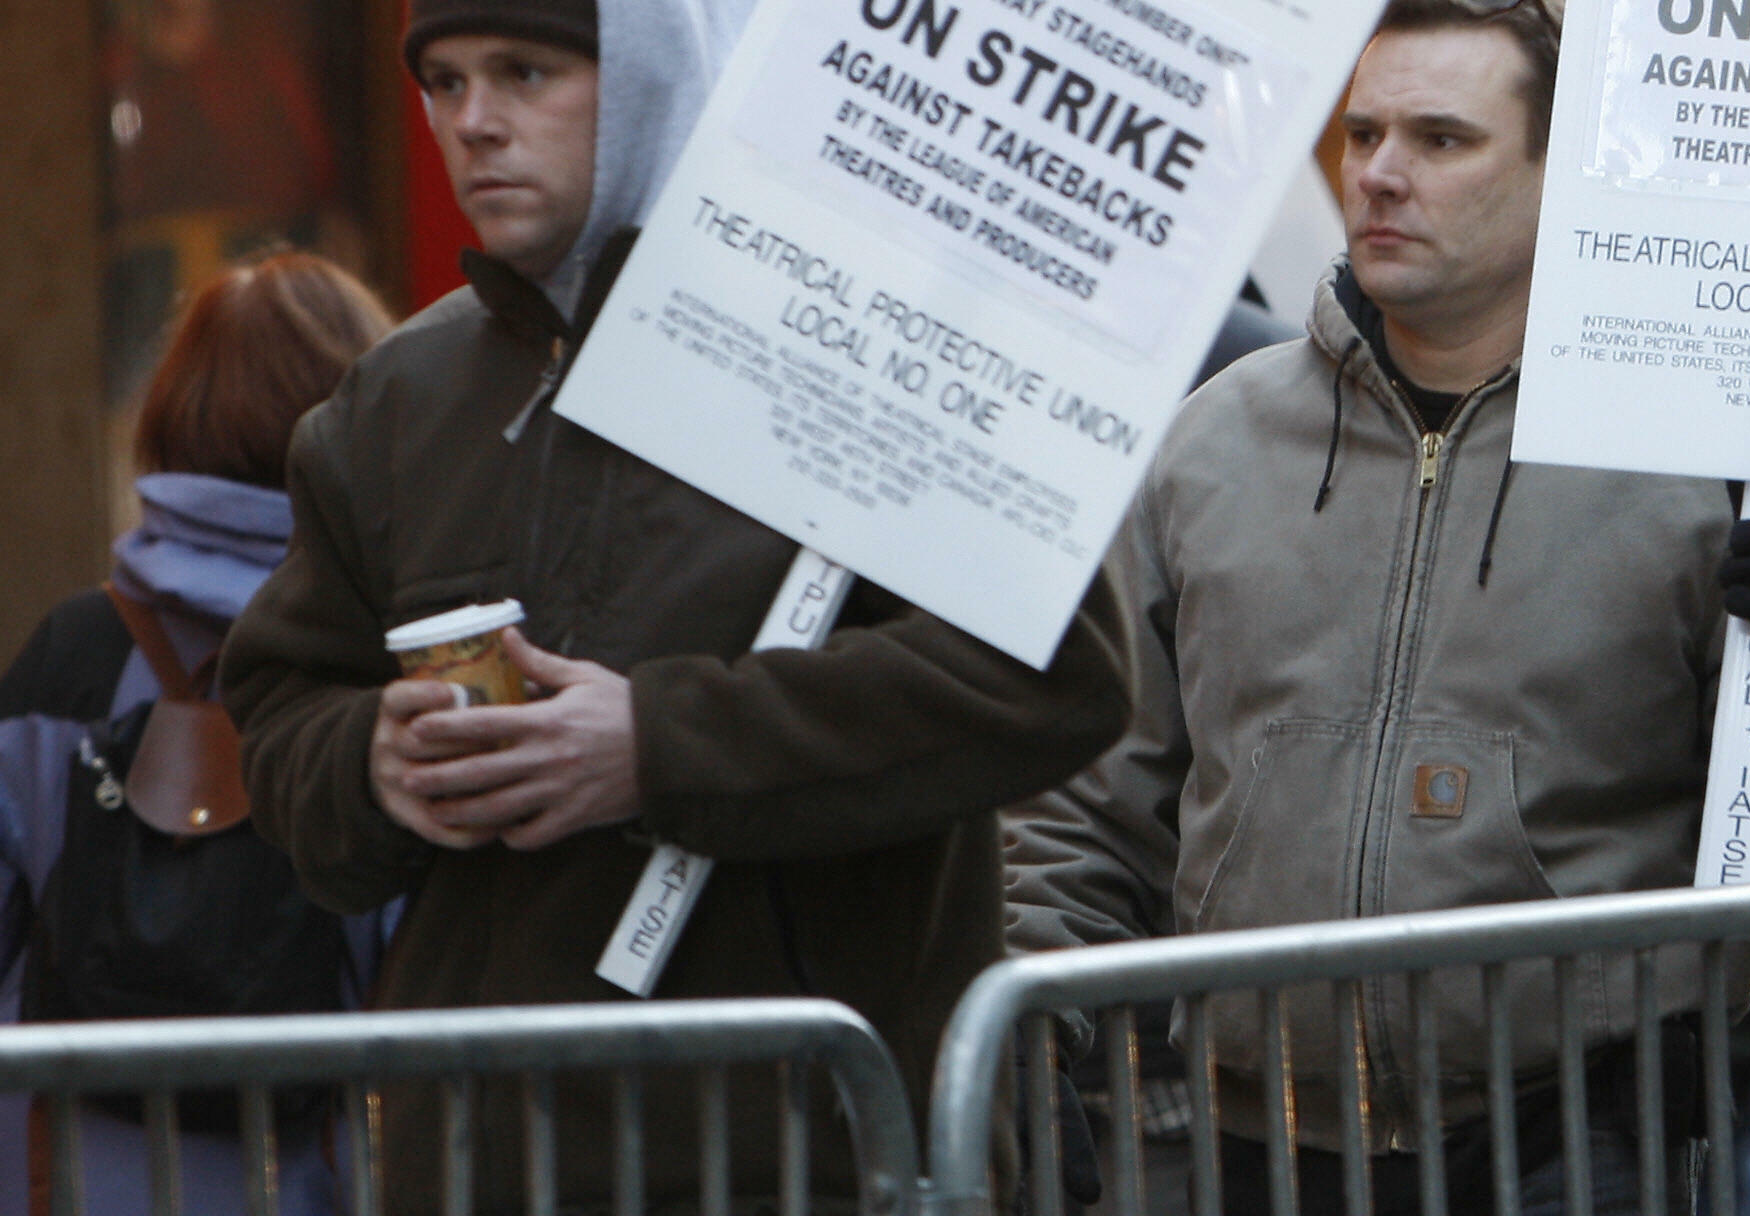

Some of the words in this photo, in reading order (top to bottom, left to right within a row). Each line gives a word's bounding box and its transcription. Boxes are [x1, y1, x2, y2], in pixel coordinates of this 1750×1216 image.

[1047, 7, 1207, 108] STAGEHANDS
[820, 39, 973, 135] AGAINST
[977, 117, 1173, 247] TAKEBACKS
[965, 29, 1205, 193] STRIKE
[1675, 101, 1704, 124] BY
[1710, 103, 1750, 129] THE
[820, 133, 925, 207] THEATRES
[924, 194, 972, 232] AND
[972, 218, 1097, 300] PRODUCERS
[835, 99, 867, 128] BY
[869, 114, 909, 152] THE
[906, 138, 987, 195] LEAGUE
[985, 180, 1016, 206] OF
[1014, 197, 1116, 265] AMERICAN
[694, 195, 852, 309] THEATRICAL
[865, 289, 1044, 406] PROTECTIVE
[1048, 389, 1136, 456] UNION
[779, 295, 869, 369] LOCAL
[939, 380, 1004, 435] ONE
[1550, 343, 1571, 358] OF
[1578, 345, 1606, 361] THE
[1611, 349, 1665, 366] UNITED
[1580, 330, 1638, 347] MOVING
[1642, 335, 1704, 353] PICTURE
[1581, 314, 1695, 337] INTERNATIONAL
[1716, 375, 1742, 389] 320
[628, 857, 687, 958] ATSE
